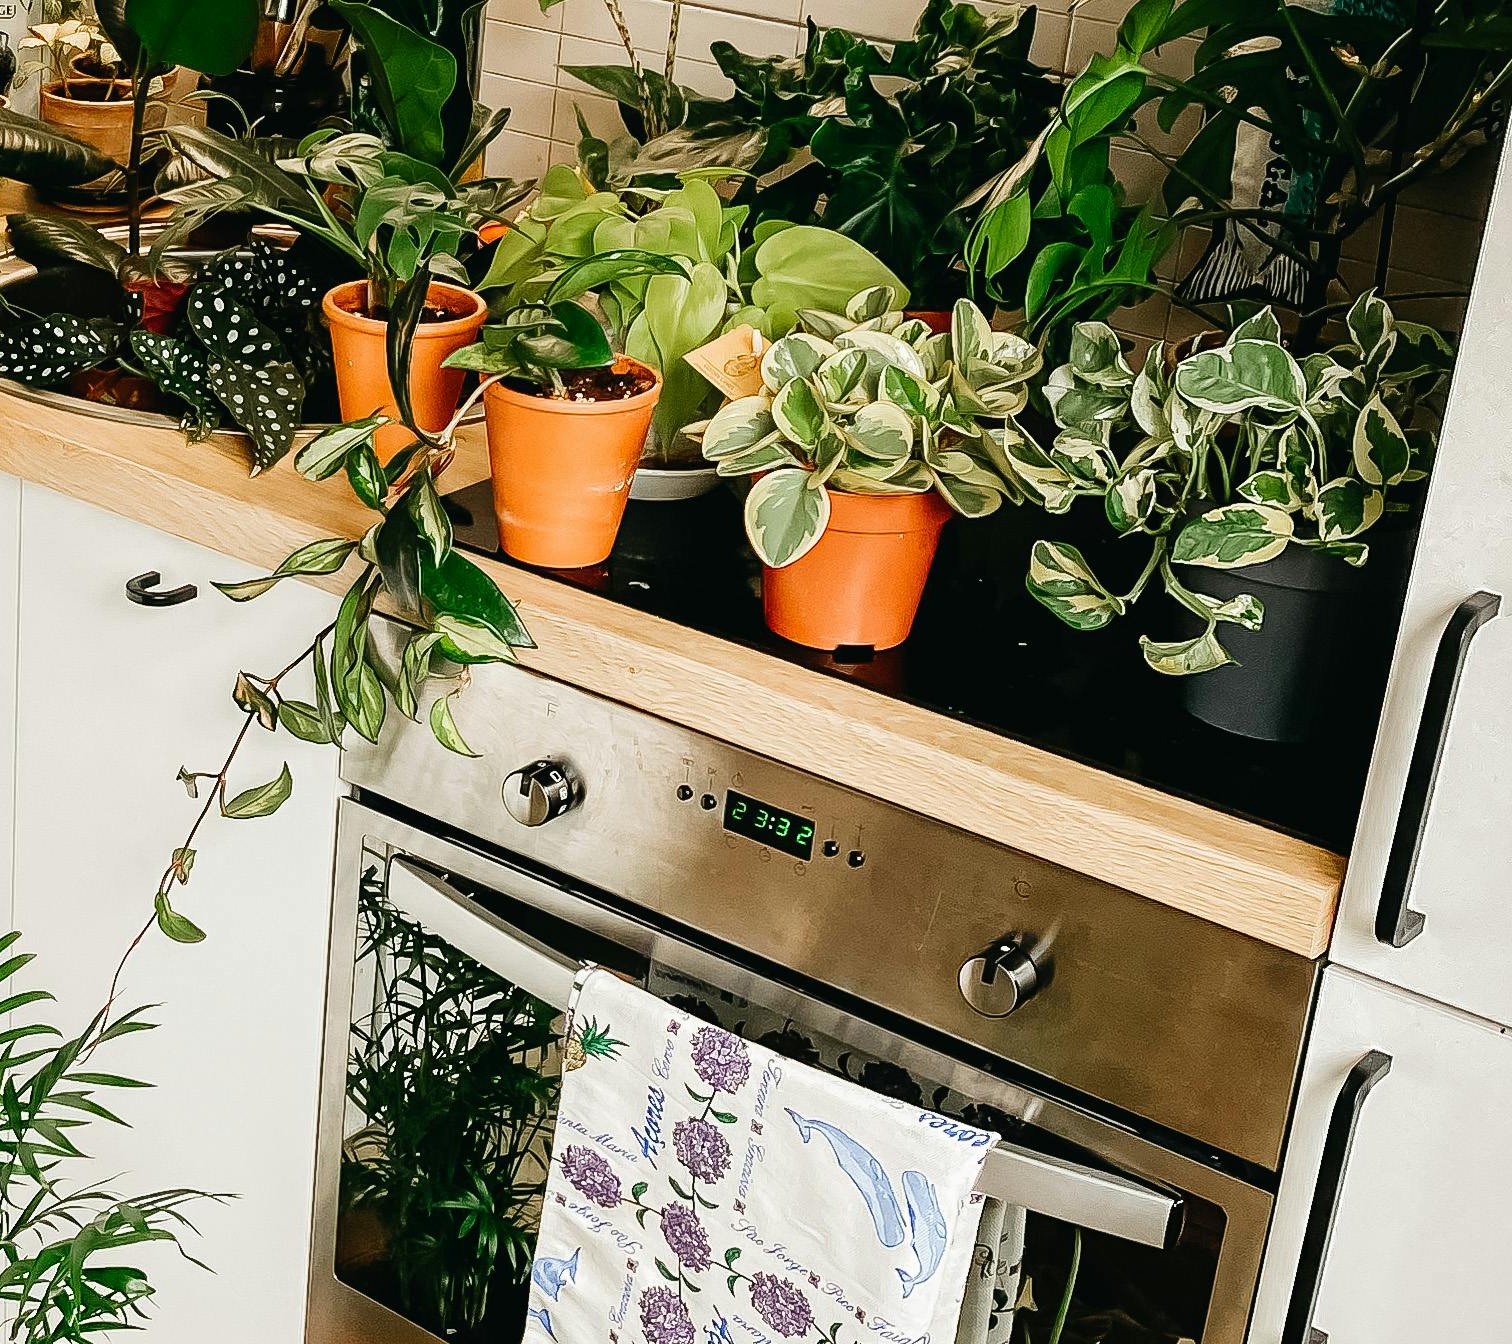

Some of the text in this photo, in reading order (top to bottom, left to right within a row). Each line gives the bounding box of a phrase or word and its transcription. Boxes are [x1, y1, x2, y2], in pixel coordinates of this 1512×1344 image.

[732, 802, 813, 846] 23:32
[556, 1111, 589, 1136] anta
[631, 1085, 666, 1171] Açores
[763, 1242, 809, 1276] Jorge
[821, 1281, 855, 1312] Pico
